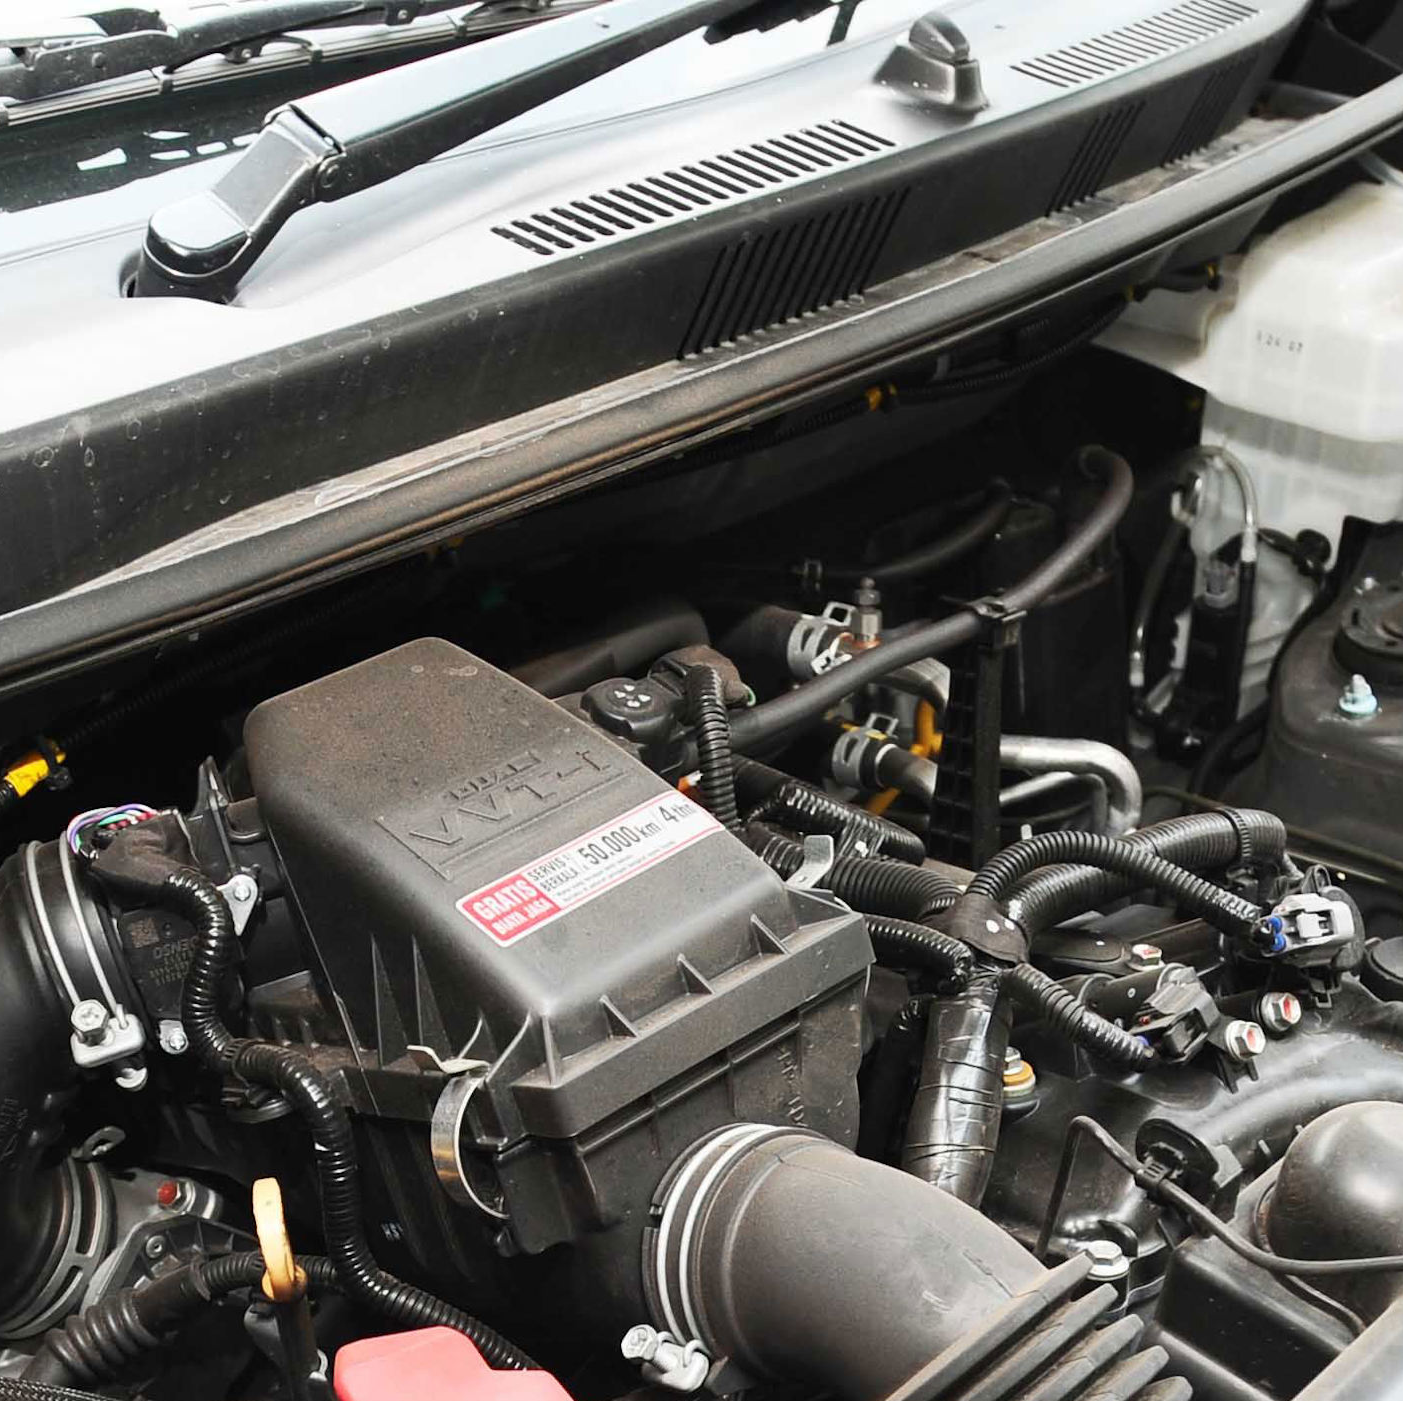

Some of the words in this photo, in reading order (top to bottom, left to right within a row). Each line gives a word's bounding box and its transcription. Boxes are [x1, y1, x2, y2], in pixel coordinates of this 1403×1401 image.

[578, 825, 642, 866] 50.000
[639, 820, 661, 839] km
[658, 805, 678, 825] 4
[527, 857, 567, 882] SERVIS
[472, 878, 538, 922] GRATIS
[491, 907, 528, 936] BIAYA
[522, 897, 555, 923] JASA
